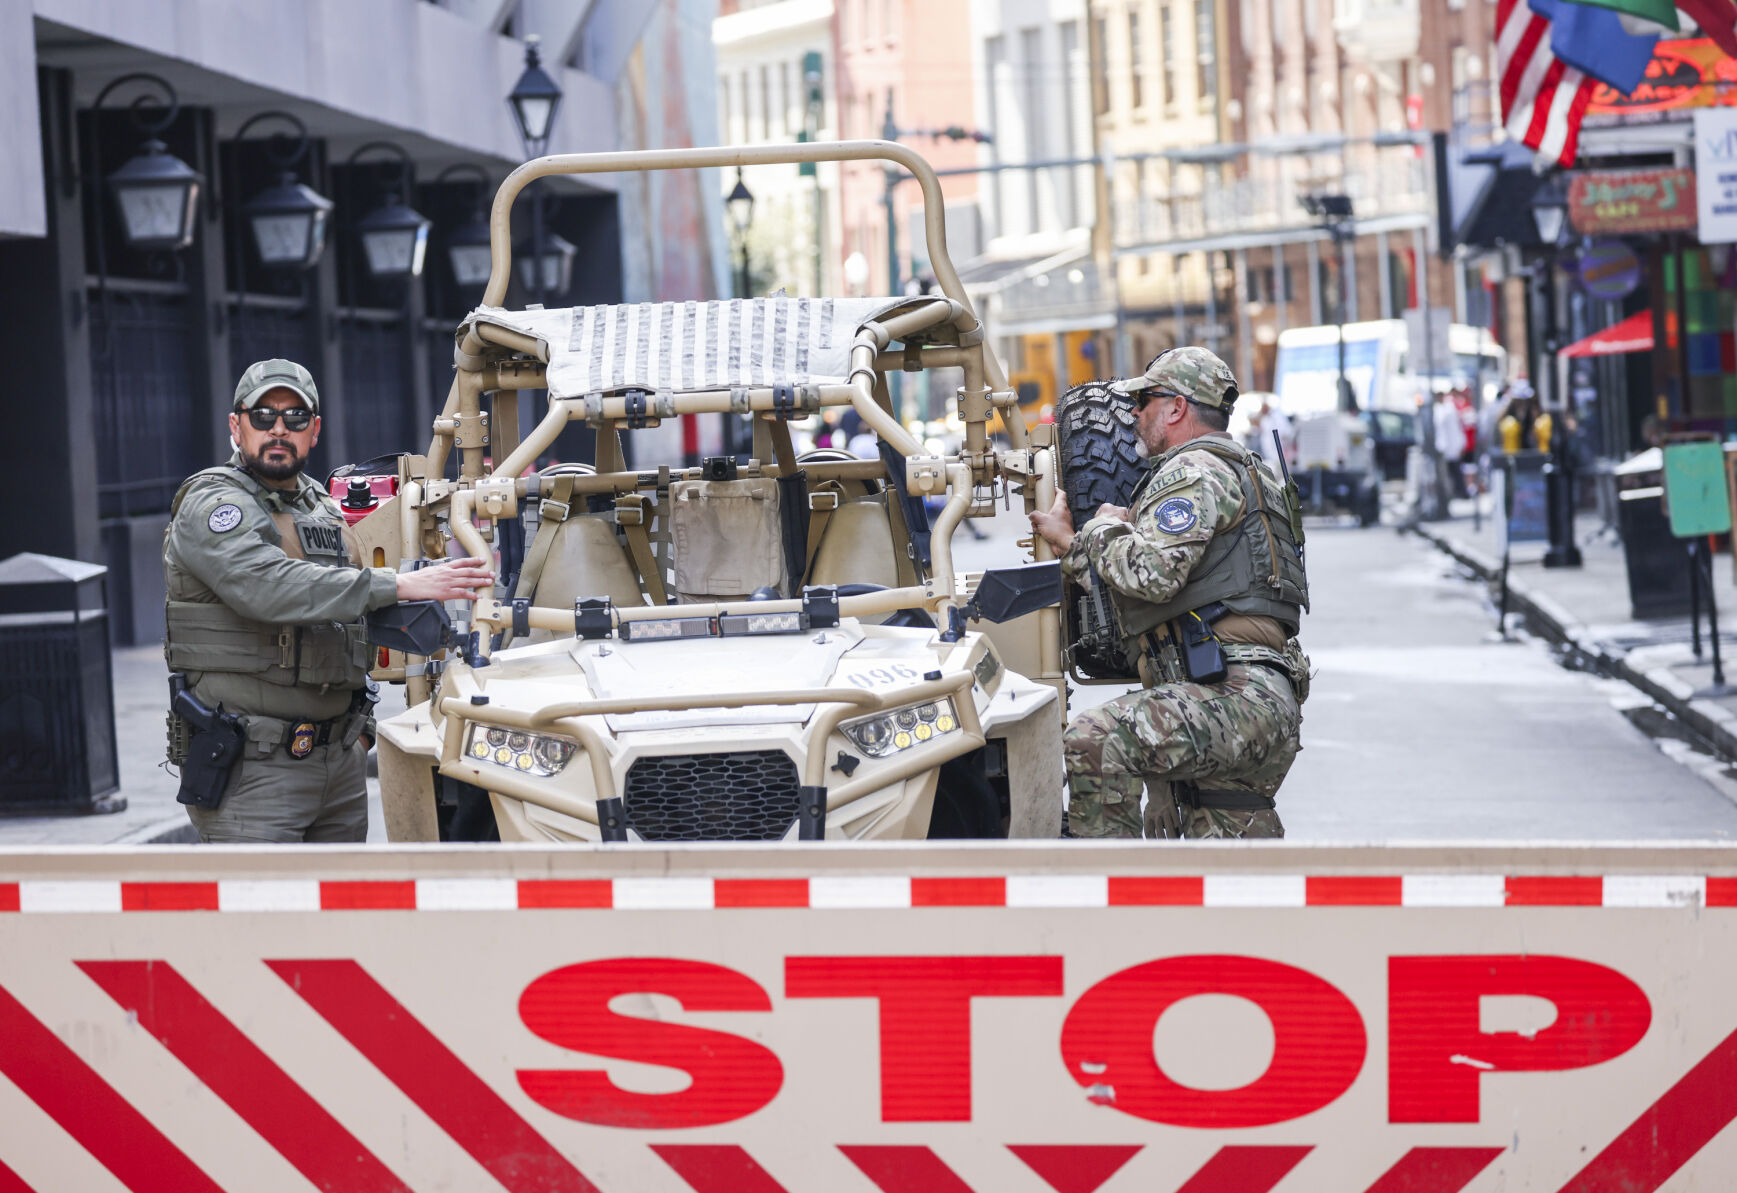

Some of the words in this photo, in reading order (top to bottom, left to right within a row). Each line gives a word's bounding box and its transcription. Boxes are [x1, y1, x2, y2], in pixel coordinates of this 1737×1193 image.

[1150, 469, 1184, 494] ATL-11
[847, 663, 918, 688] 096
[515, 954, 1652, 1129] STOP
